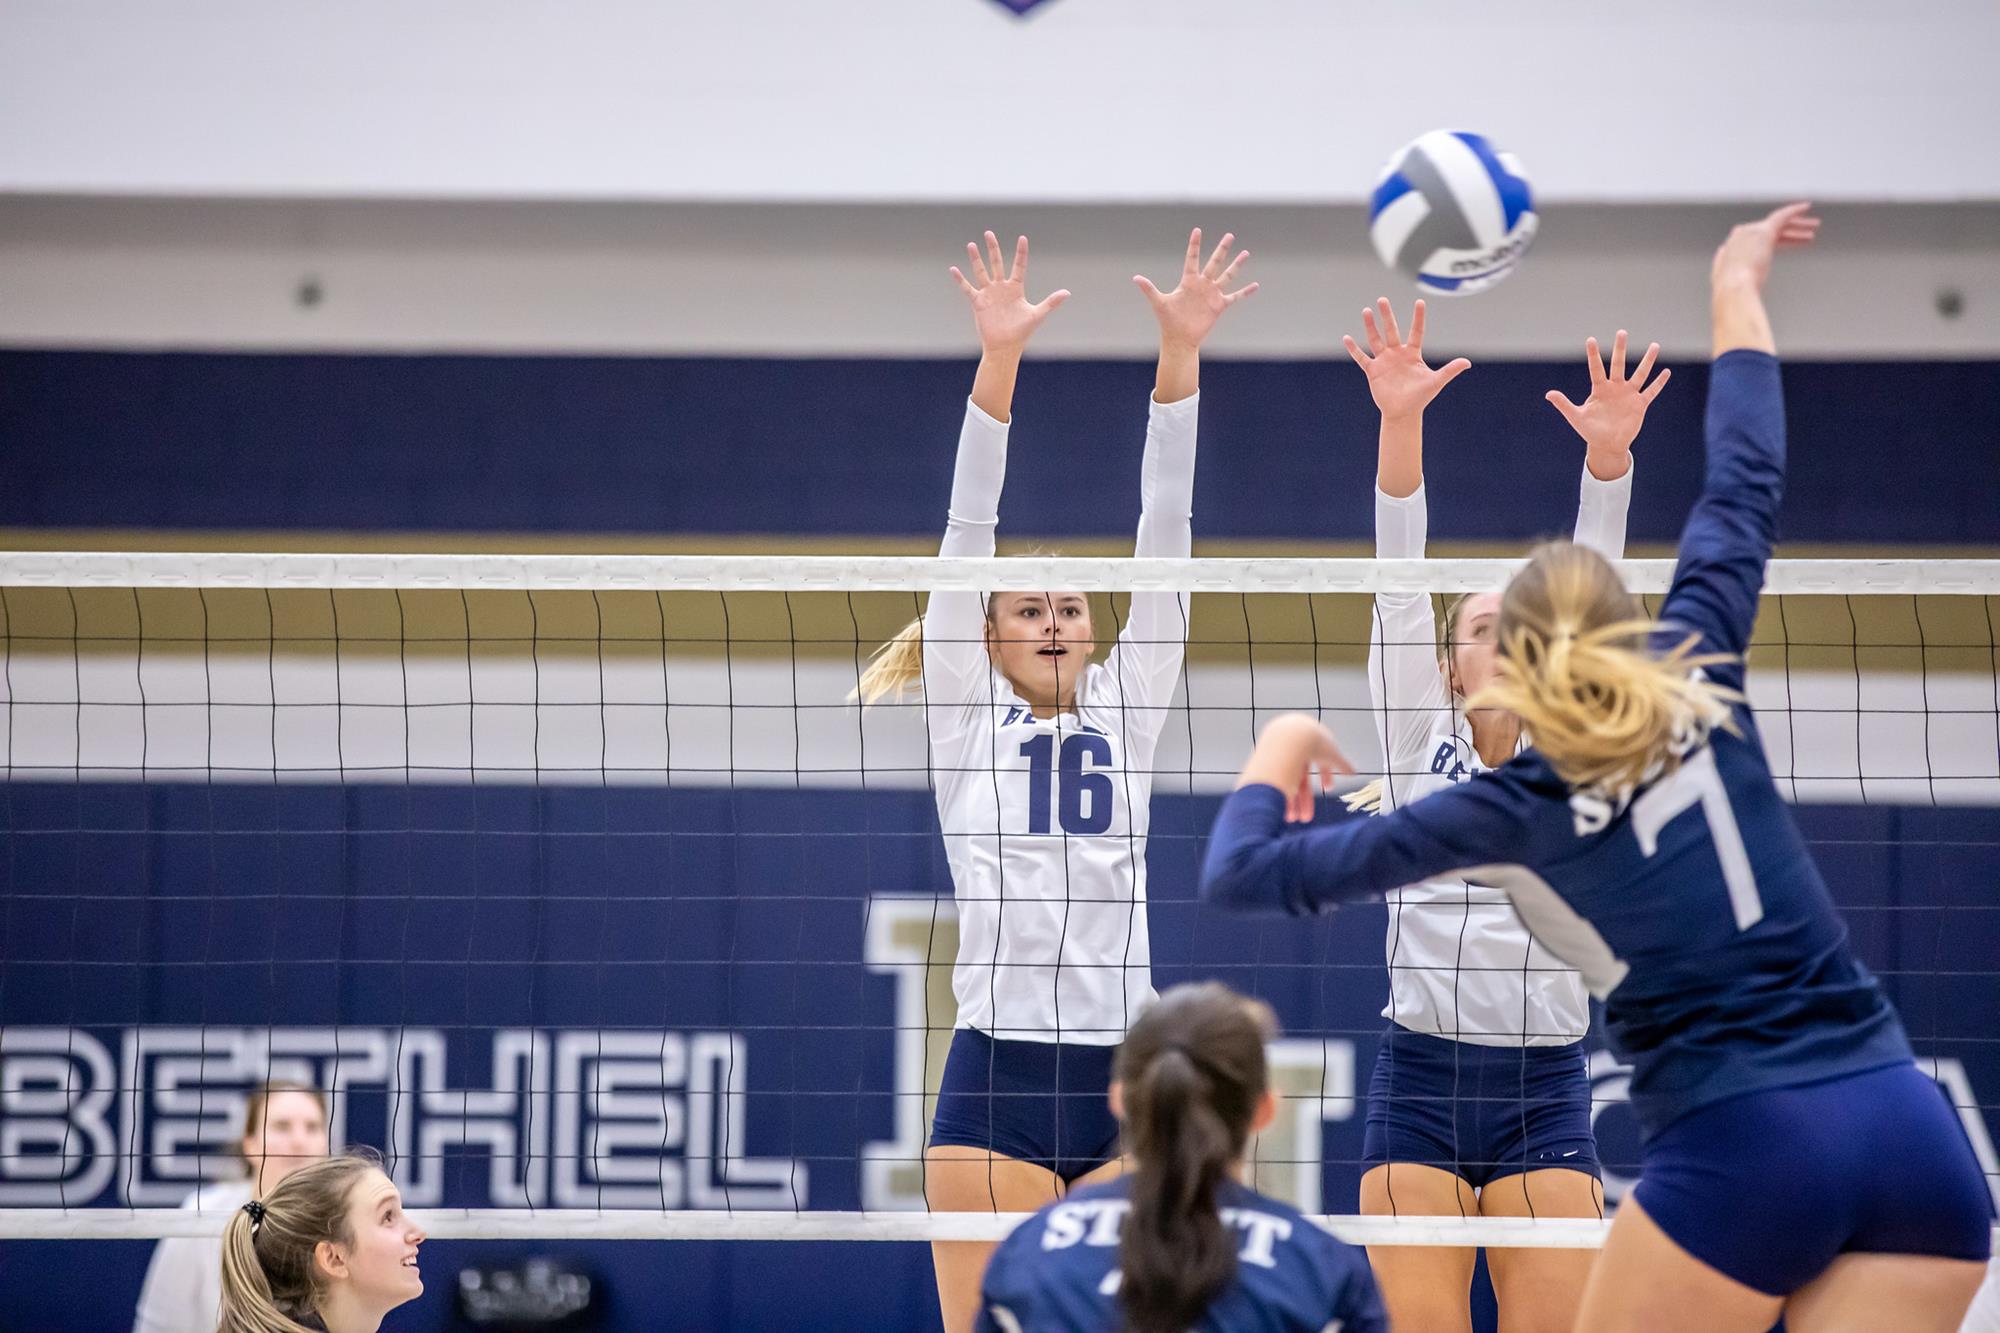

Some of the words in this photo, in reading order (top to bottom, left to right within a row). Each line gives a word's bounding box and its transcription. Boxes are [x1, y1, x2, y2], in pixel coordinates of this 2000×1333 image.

[1019, 733, 1113, 835] 16
[1631, 740, 1764, 932] 7
[0, 1028, 808, 1210] BETHEL
[1040, 1199, 1293, 1269] STT
